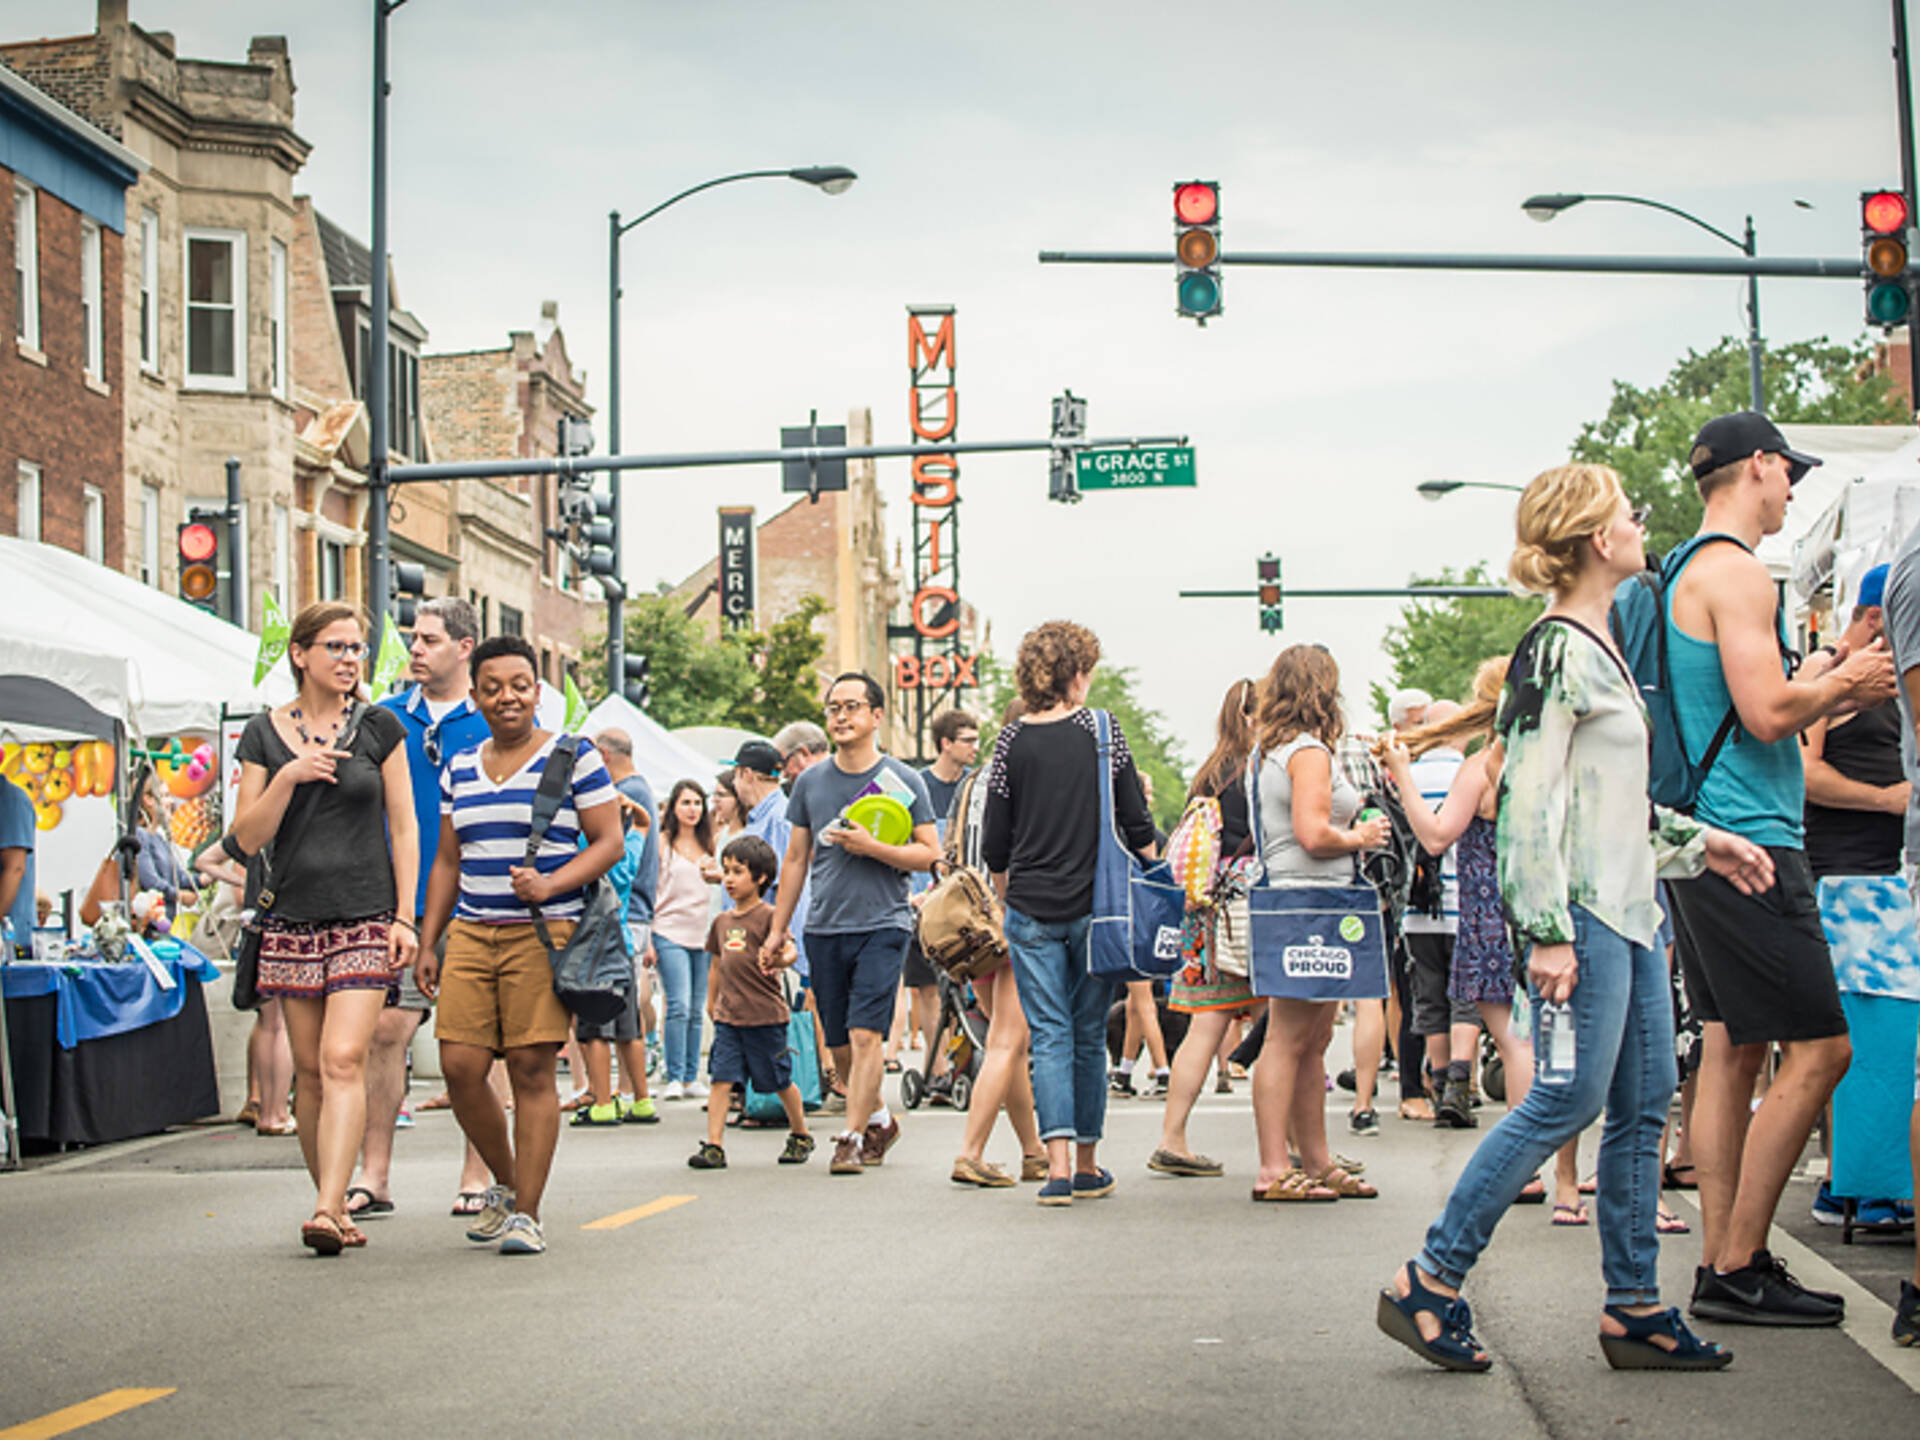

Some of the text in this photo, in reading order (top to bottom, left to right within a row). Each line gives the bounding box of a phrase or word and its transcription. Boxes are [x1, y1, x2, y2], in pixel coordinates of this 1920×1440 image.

[1095, 452, 1169, 471] GRACE
[1174, 454, 1189, 466] ST
[908, 313, 960, 638] MUSIC
[1111, 472, 1146, 485] 3800
[897, 655, 979, 689] BOX
[1287, 948, 1348, 960] CHICAGO
[1288, 961, 1349, 974] PROUD
